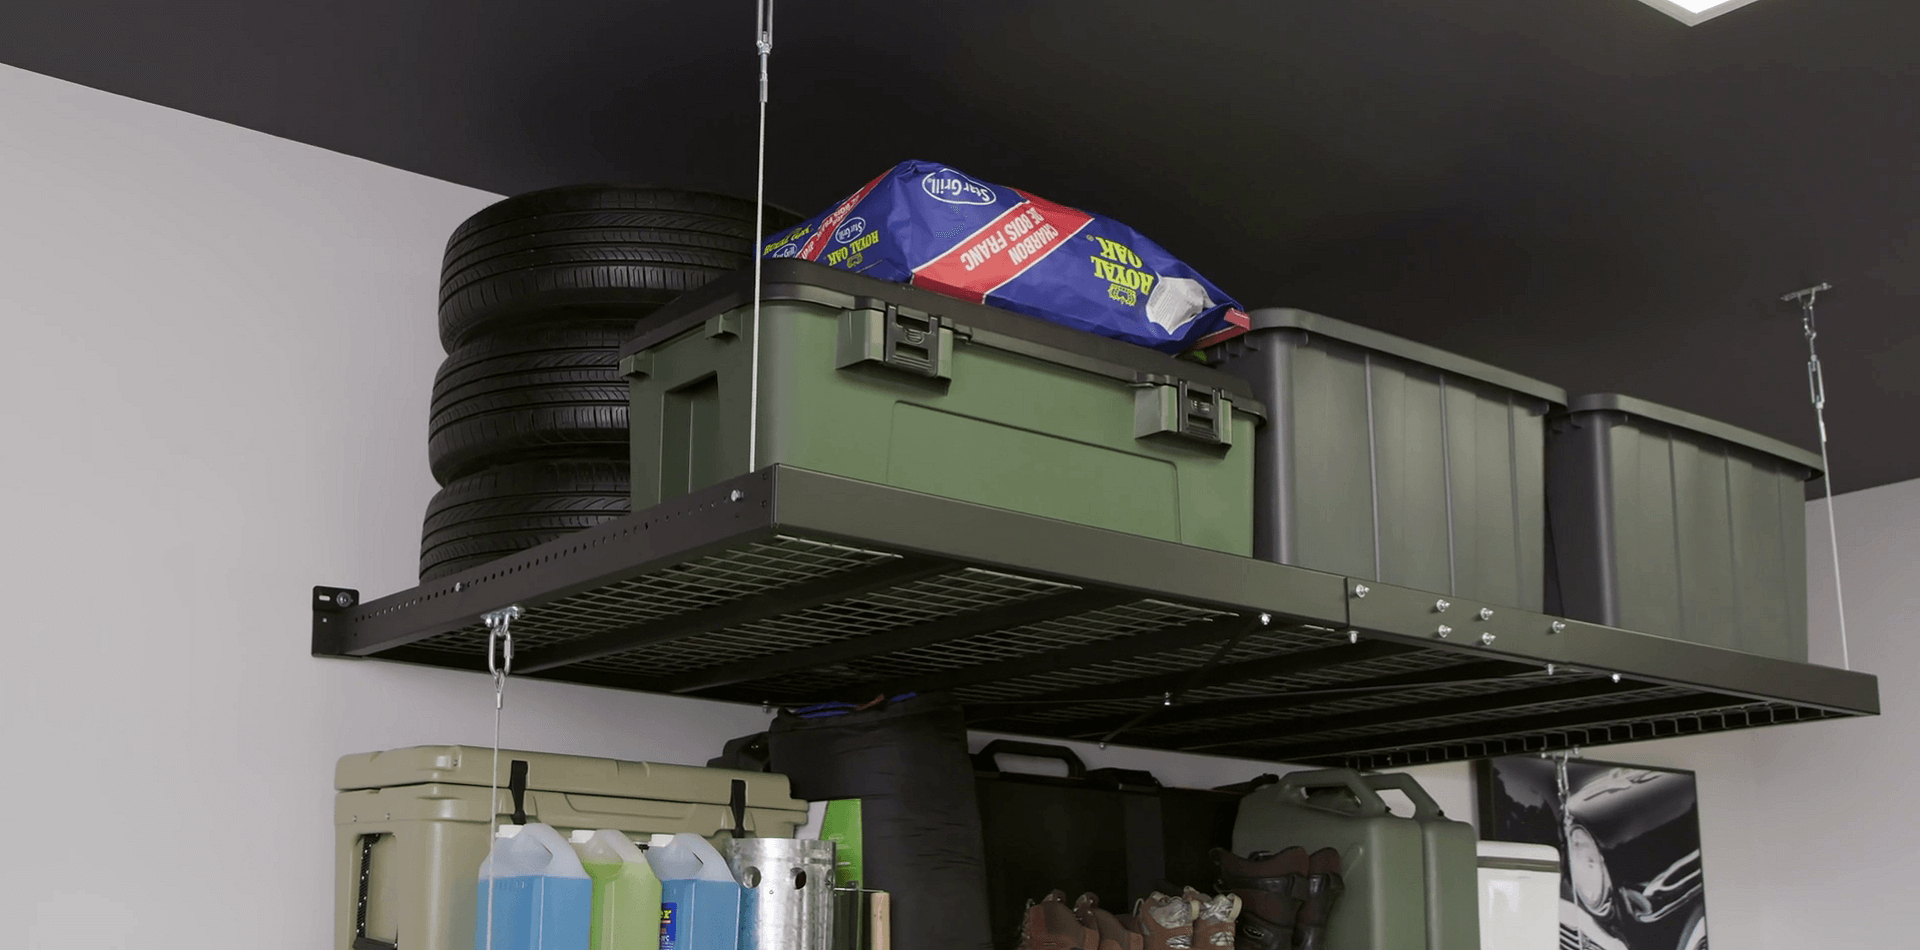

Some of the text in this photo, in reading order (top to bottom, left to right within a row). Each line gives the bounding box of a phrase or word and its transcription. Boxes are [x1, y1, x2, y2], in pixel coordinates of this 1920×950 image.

[827, 230, 879, 267] ROYAL OAK
[960, 207, 1045, 271] DE BOIS FRANC
[1007, 223, 1059, 266] CHARBON
[1095, 236, 1143, 269] OAK
[1090, 255, 1154, 295] ROYAL
